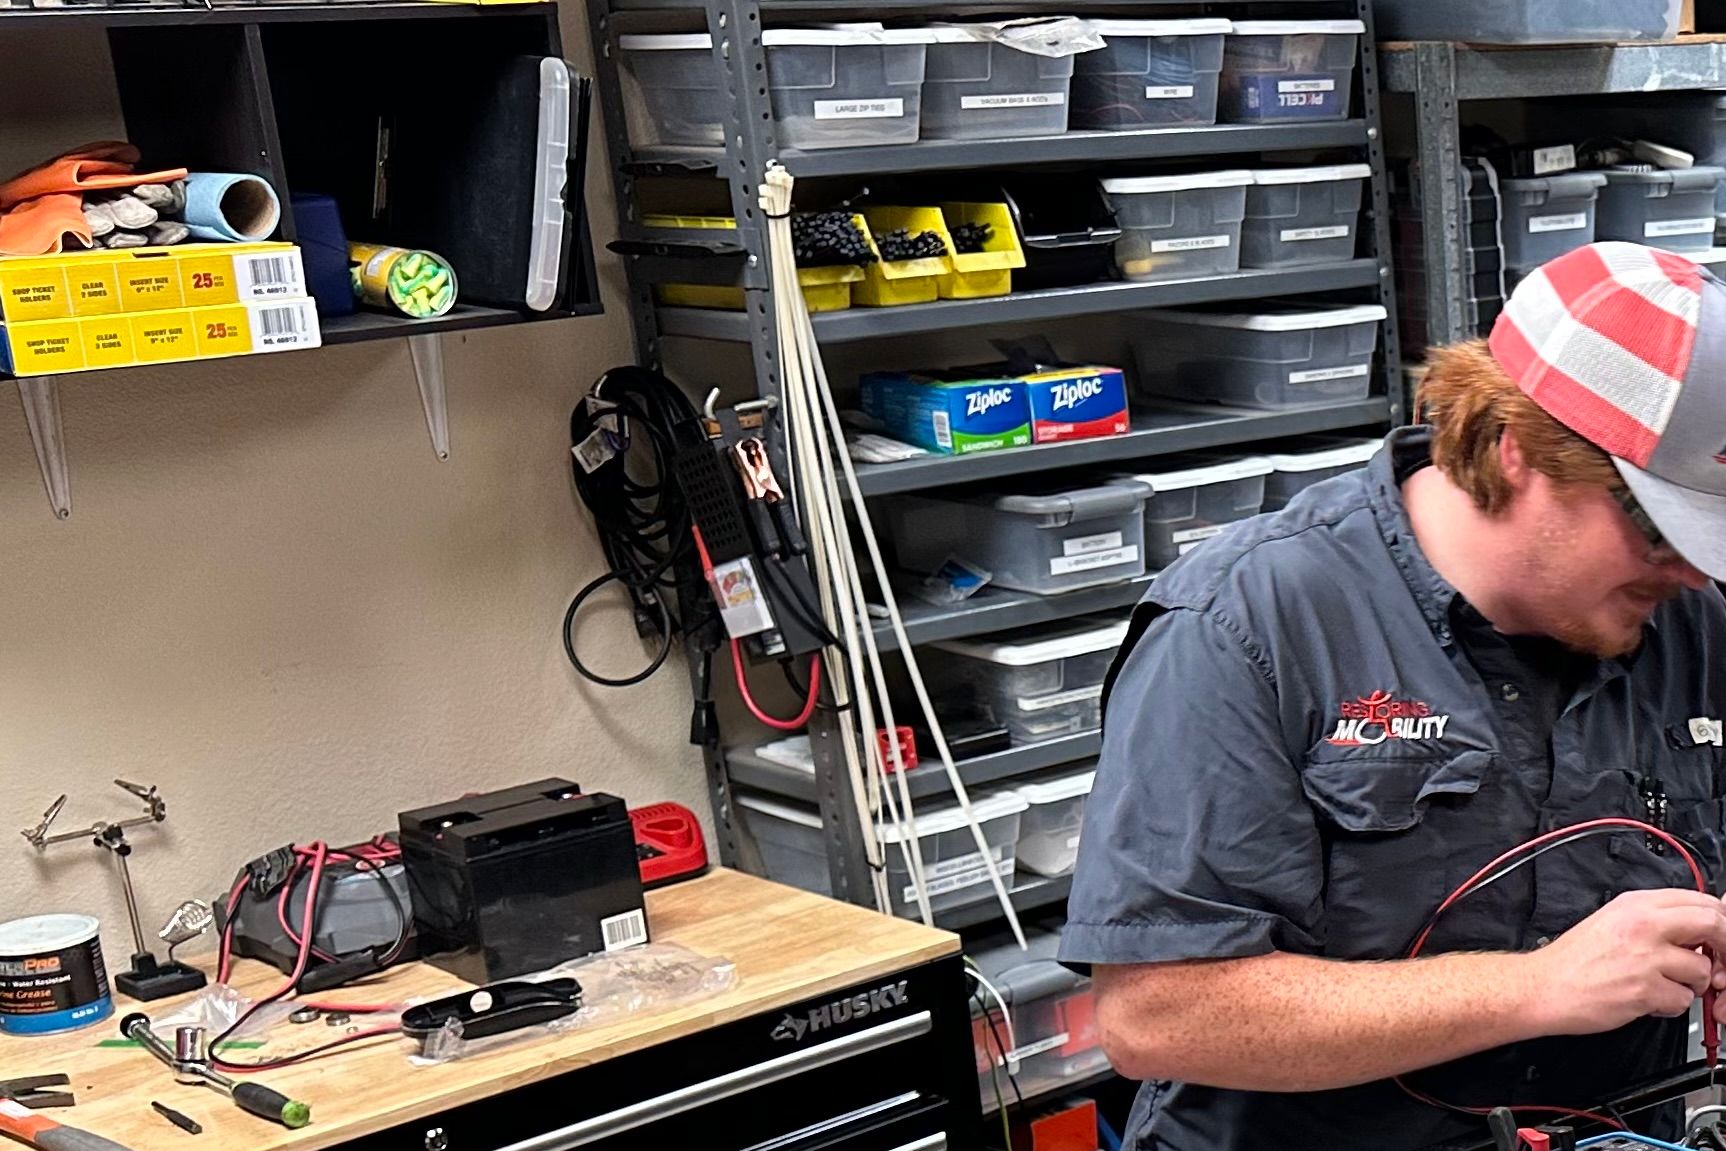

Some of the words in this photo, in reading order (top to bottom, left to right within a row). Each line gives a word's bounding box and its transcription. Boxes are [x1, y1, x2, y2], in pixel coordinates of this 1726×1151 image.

[82, 282, 104, 290] CLEAR
[129, 278, 153, 287] INSERT
[192, 273, 214, 289] 25
[12, 287, 31, 296] SHOP
[32, 285, 55, 294] TICKET
[20, 294, 51, 303] HOLDERS
[144, 329, 167, 337] INSERT
[206, 323, 227, 339] 25
[26, 340, 46, 348] SHOP
[47, 338, 70, 346] TICKET
[96, 333, 118, 342] CLEAR
[34, 346, 66, 355] HOLDERS
[1050, 377, 1104, 412] Ziploc
[965, 388, 1012, 417] Ziploc
[962, 439, 1004, 452] SANDWICH
[1340, 699, 1432, 719] RESTORING
[1329, 714, 1450, 745] MOBILITY
[16, 989, 52, 999] Grease
[808, 980, 909, 1032] HUSKY
